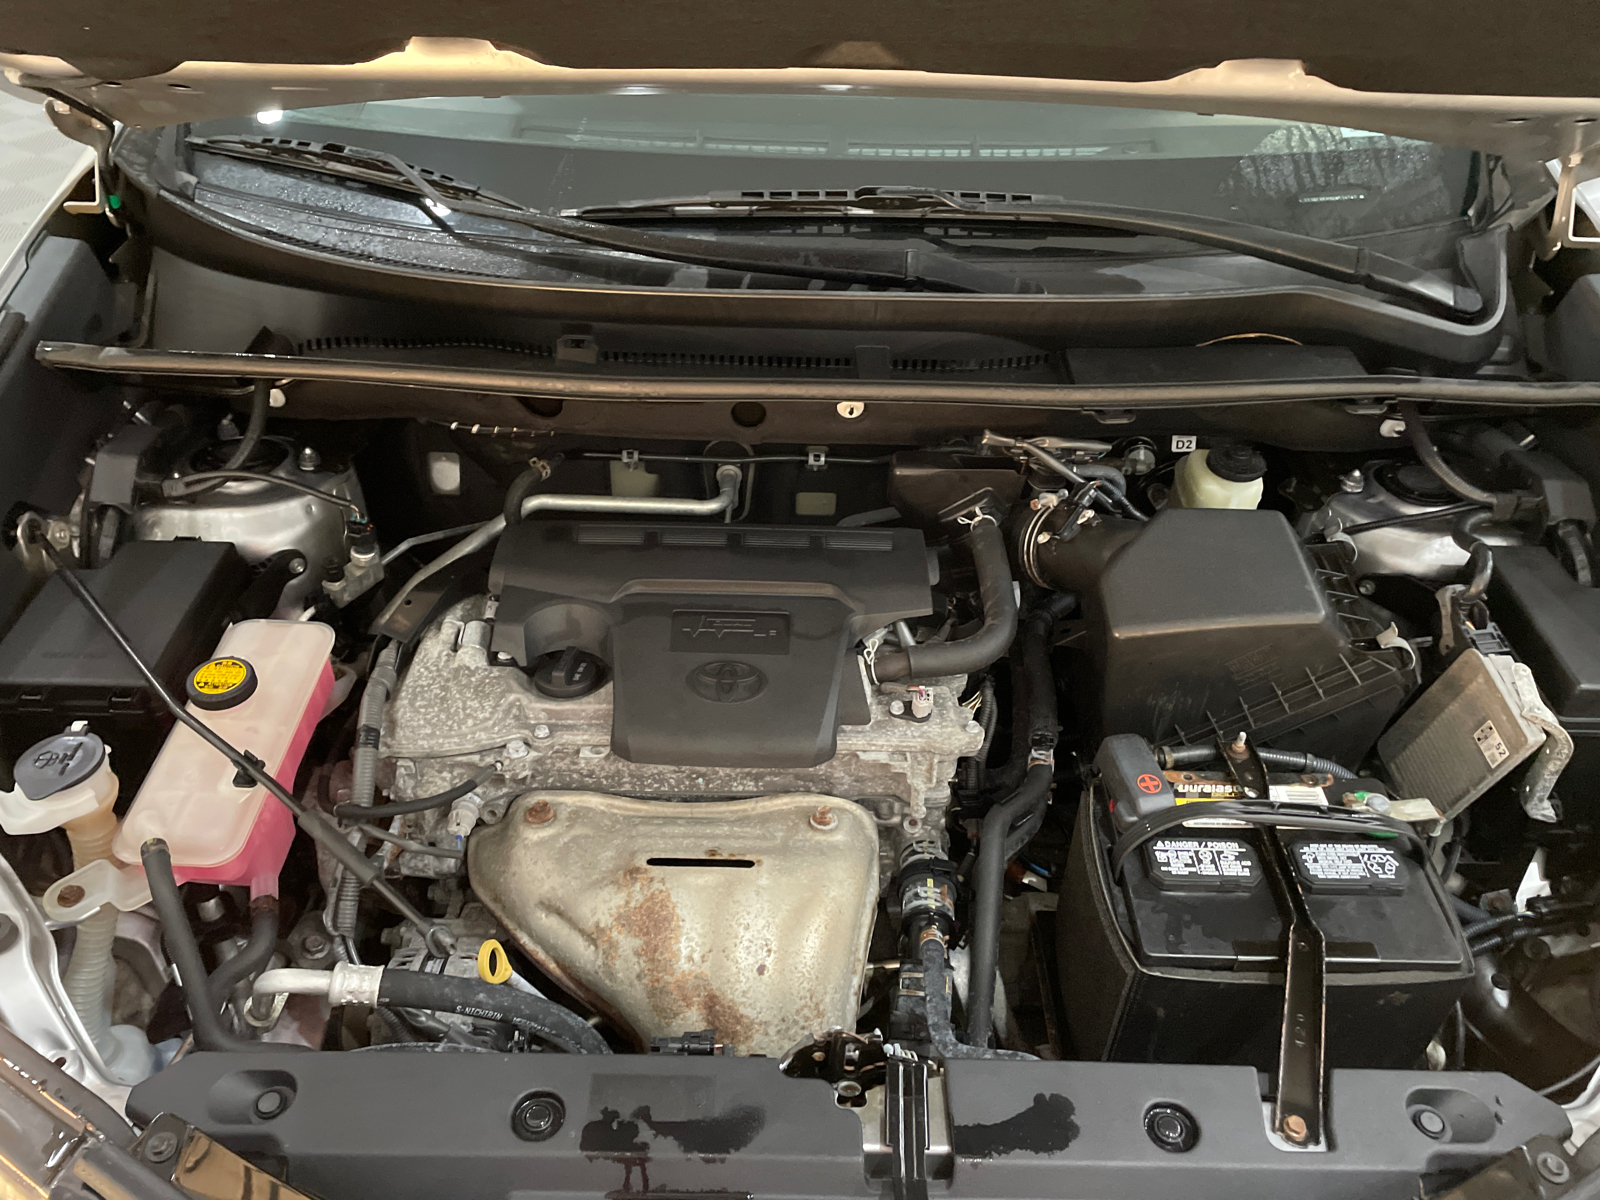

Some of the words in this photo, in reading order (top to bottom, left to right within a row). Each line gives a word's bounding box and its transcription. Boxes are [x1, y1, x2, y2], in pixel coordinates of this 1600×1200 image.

[1175, 439, 1193, 450] D2
[1164, 840, 1200, 849] DANGER
[1207, 841, 1240, 850] POISON
[455, 1005, 503, 1021] S-NICHIRIN
